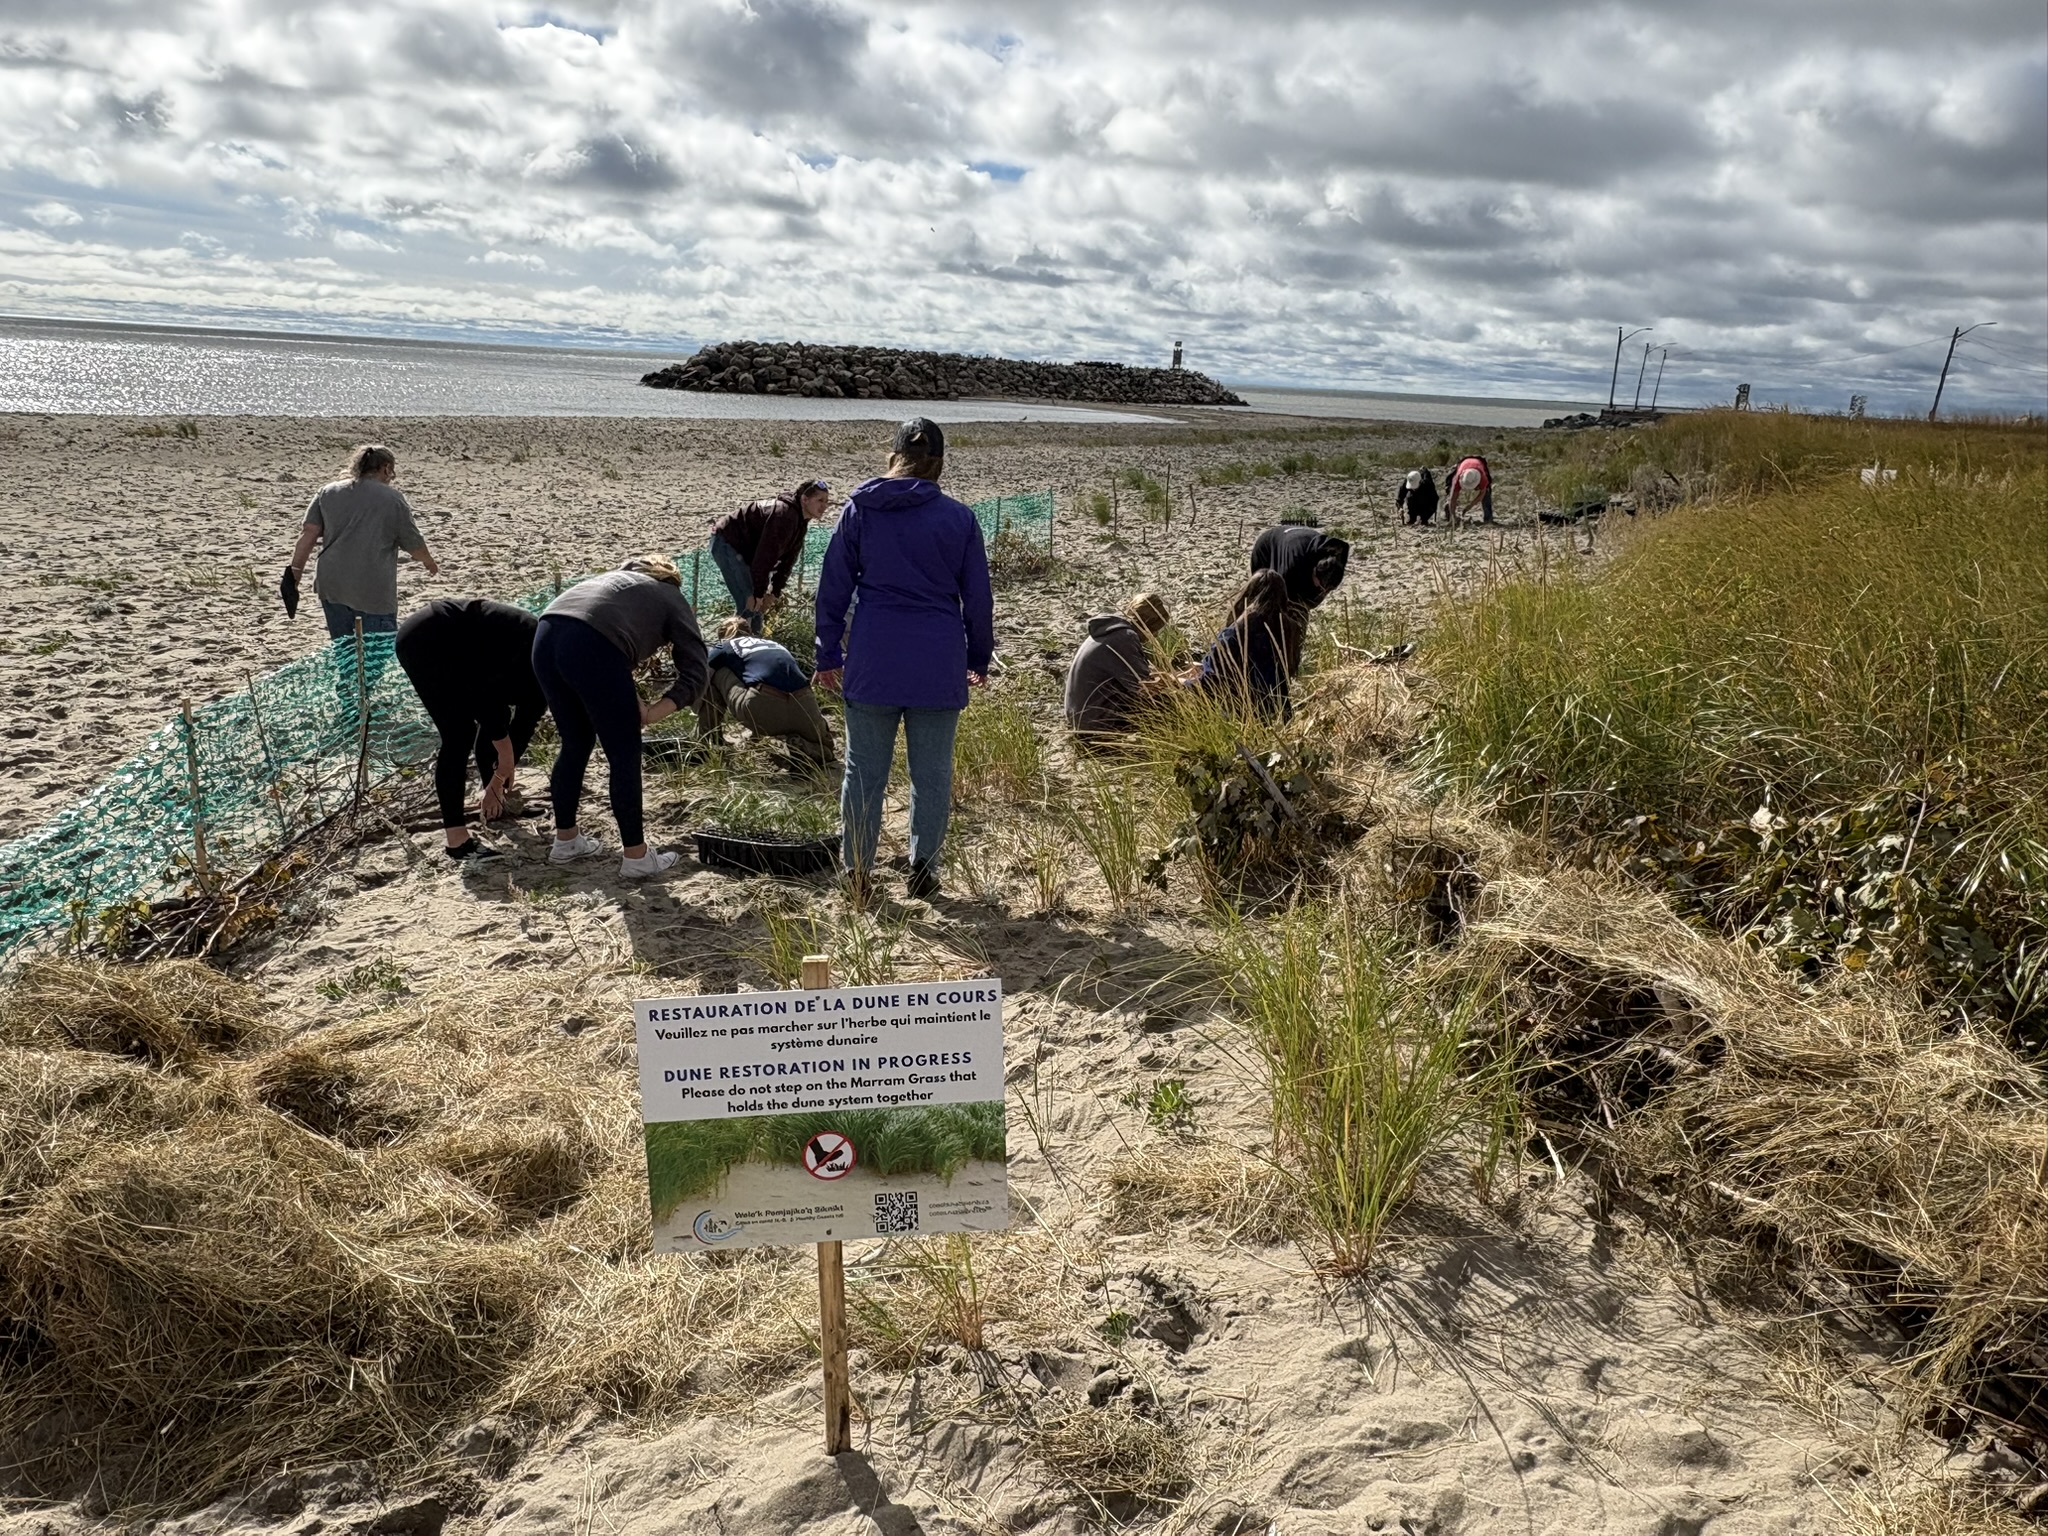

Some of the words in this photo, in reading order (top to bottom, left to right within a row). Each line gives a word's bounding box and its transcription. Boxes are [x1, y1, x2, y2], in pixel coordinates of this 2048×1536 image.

[649, 1001, 787, 1022] RESTAURATION
[795, 999, 816, 1013] DE
[823, 998, 846, 1012] LA
[852, 994, 900, 1010] DUNE
[907, 993, 929, 1006] EN
[936, 989, 998, 1005] COURS
[655, 1026, 708, 1041] Veuillez
[711, 1028, 727, 1037] ne
[731, 1026, 755, 1039] pas
[758, 1020, 814, 1035] marcher
[817, 1021, 838, 1031] sur
[841, 1015, 887, 1029] l'herbe
[890, 1013, 911, 1029] qui
[915, 1010, 977, 1026] maintient
[980, 1008, 992, 1022] le
[770, 1036, 824, 1053] système
[826, 1033, 879, 1048] dunaire
[664, 1067, 712, 1083] DUNE
[719, 1059, 845, 1081] RESTORATION
[852, 1057, 870, 1071] IN
[878, 1051, 972, 1071] PROGRESS
[682, 1087, 725, 1100] Please
[728, 1084, 746, 1096] do
[749, 1083, 772, 1095] not
[774, 1080, 803, 1094] step
[805, 1080, 823, 1091] on
[826, 1077, 848, 1090] the
[850, 1075, 905, 1089] Marram
[908, 1072, 947, 1085] Grass
[950, 1070, 977, 1082] that
[727, 1100, 764, 1113] holds
[766, 1098, 789, 1110] the
[791, 1096, 826, 1109] dune
[828, 1095, 876, 1110] system
[876, 1089, 935, 1106] together
